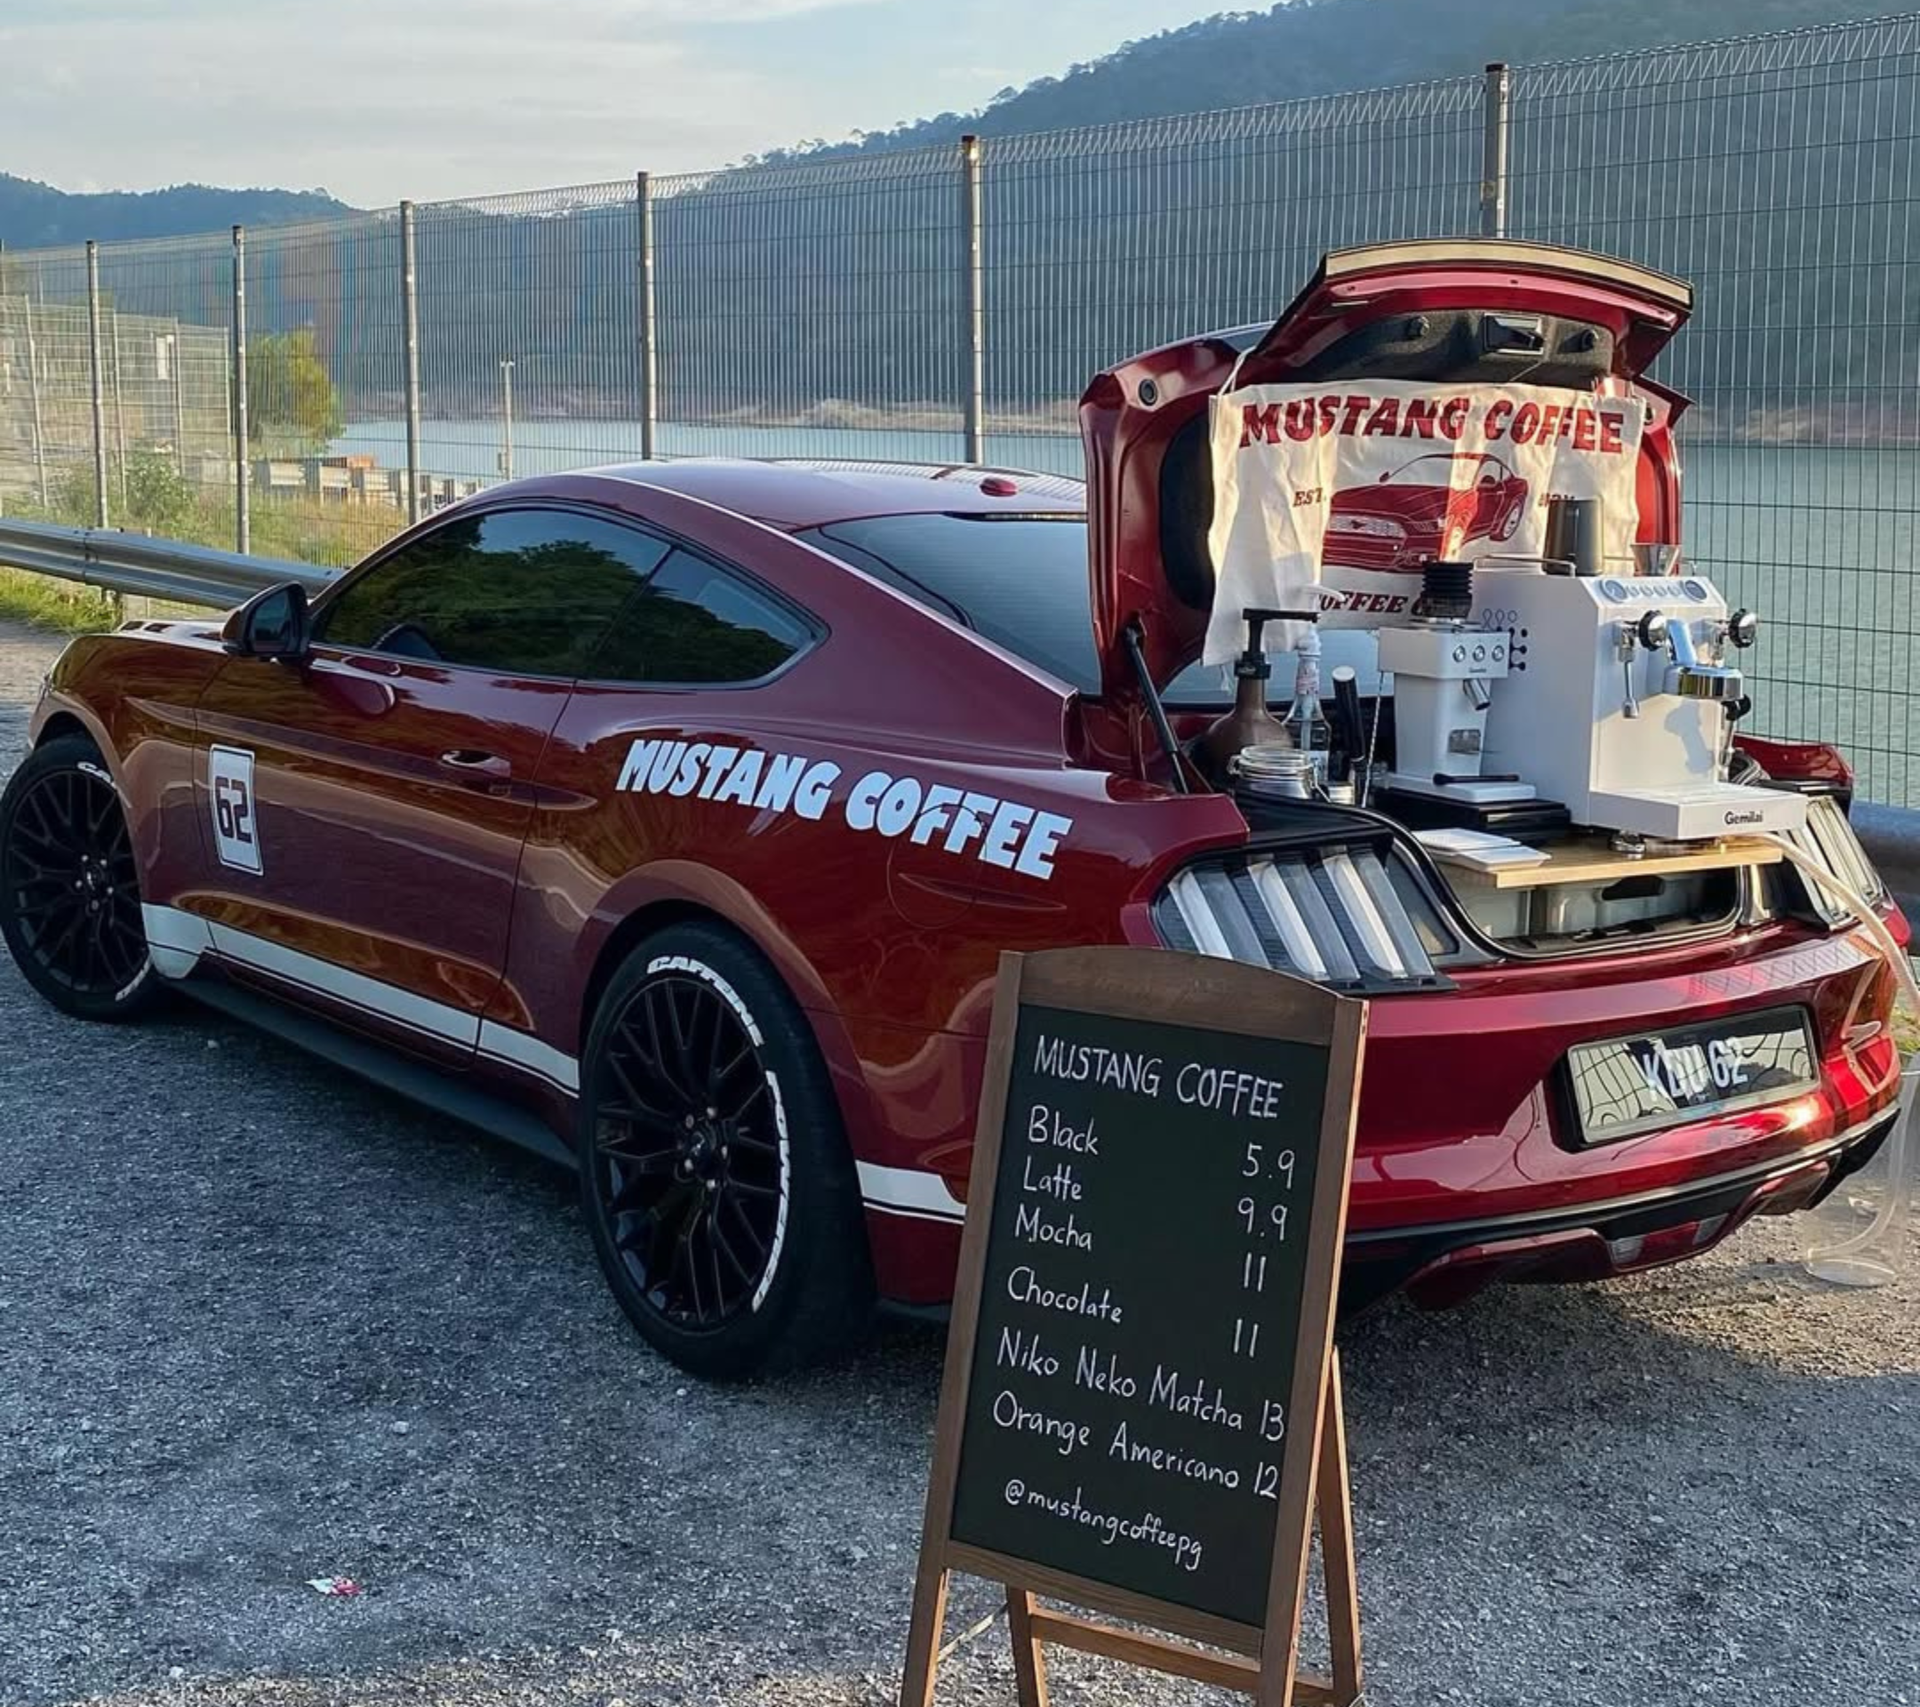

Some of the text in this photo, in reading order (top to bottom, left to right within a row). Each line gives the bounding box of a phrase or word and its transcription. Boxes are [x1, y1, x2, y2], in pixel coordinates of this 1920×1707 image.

[1239, 396, 1625, 455] MUSTANG COFFEE
[1319, 591, 1408, 612] OFFEE
[215, 776, 252, 843] 62
[615, 738, 1074, 881] MUSTANG COFFEE
[1724, 810, 1764, 825] Gemilai
[1034, 1035, 1283, 1118] MUSTANG COFFEE
[1709, 1037, 1749, 1089] 62
[1027, 1105, 1295, 1189] Black 5.9
[1022, 1155, 1288, 1241] Latte 9.9
[1015, 1203, 1267, 1292] Mocha 11
[1007, 1266, 1259, 1358] Chocolate 11
[996, 1326, 1285, 1442] Niko Neko Matcha 13
[993, 1390, 1280, 1500] Orange Americano 12
[1004, 1479, 1202, 1572] @mustangcoffeepg
